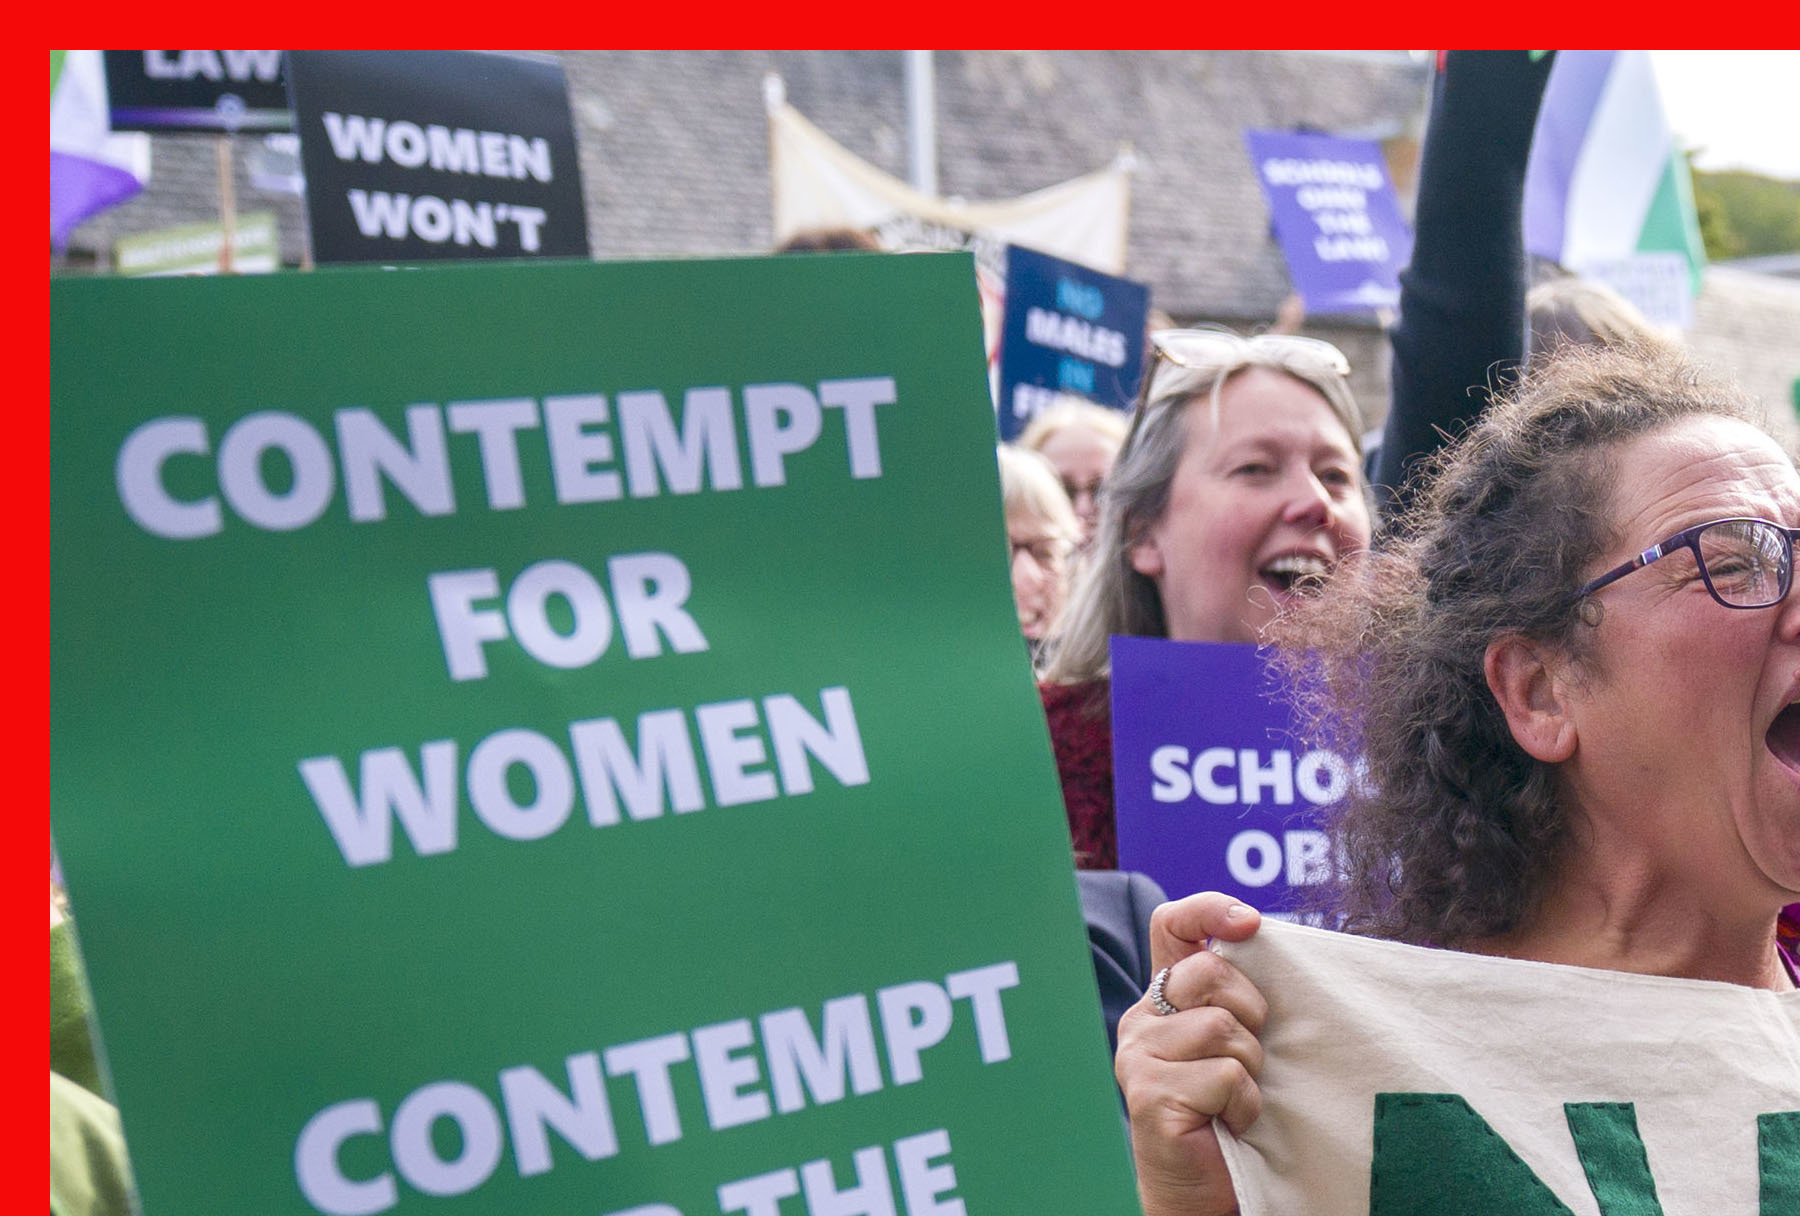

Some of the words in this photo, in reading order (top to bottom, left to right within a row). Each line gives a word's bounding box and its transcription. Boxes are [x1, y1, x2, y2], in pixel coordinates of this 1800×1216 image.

[322, 111, 552, 183] WOMEN
[347, 188, 547, 252] WON'T
[115, 377, 898, 540] CONTEMPT
[427, 551, 711, 682] FOR
[297, 686, 872, 868] WOMEN
